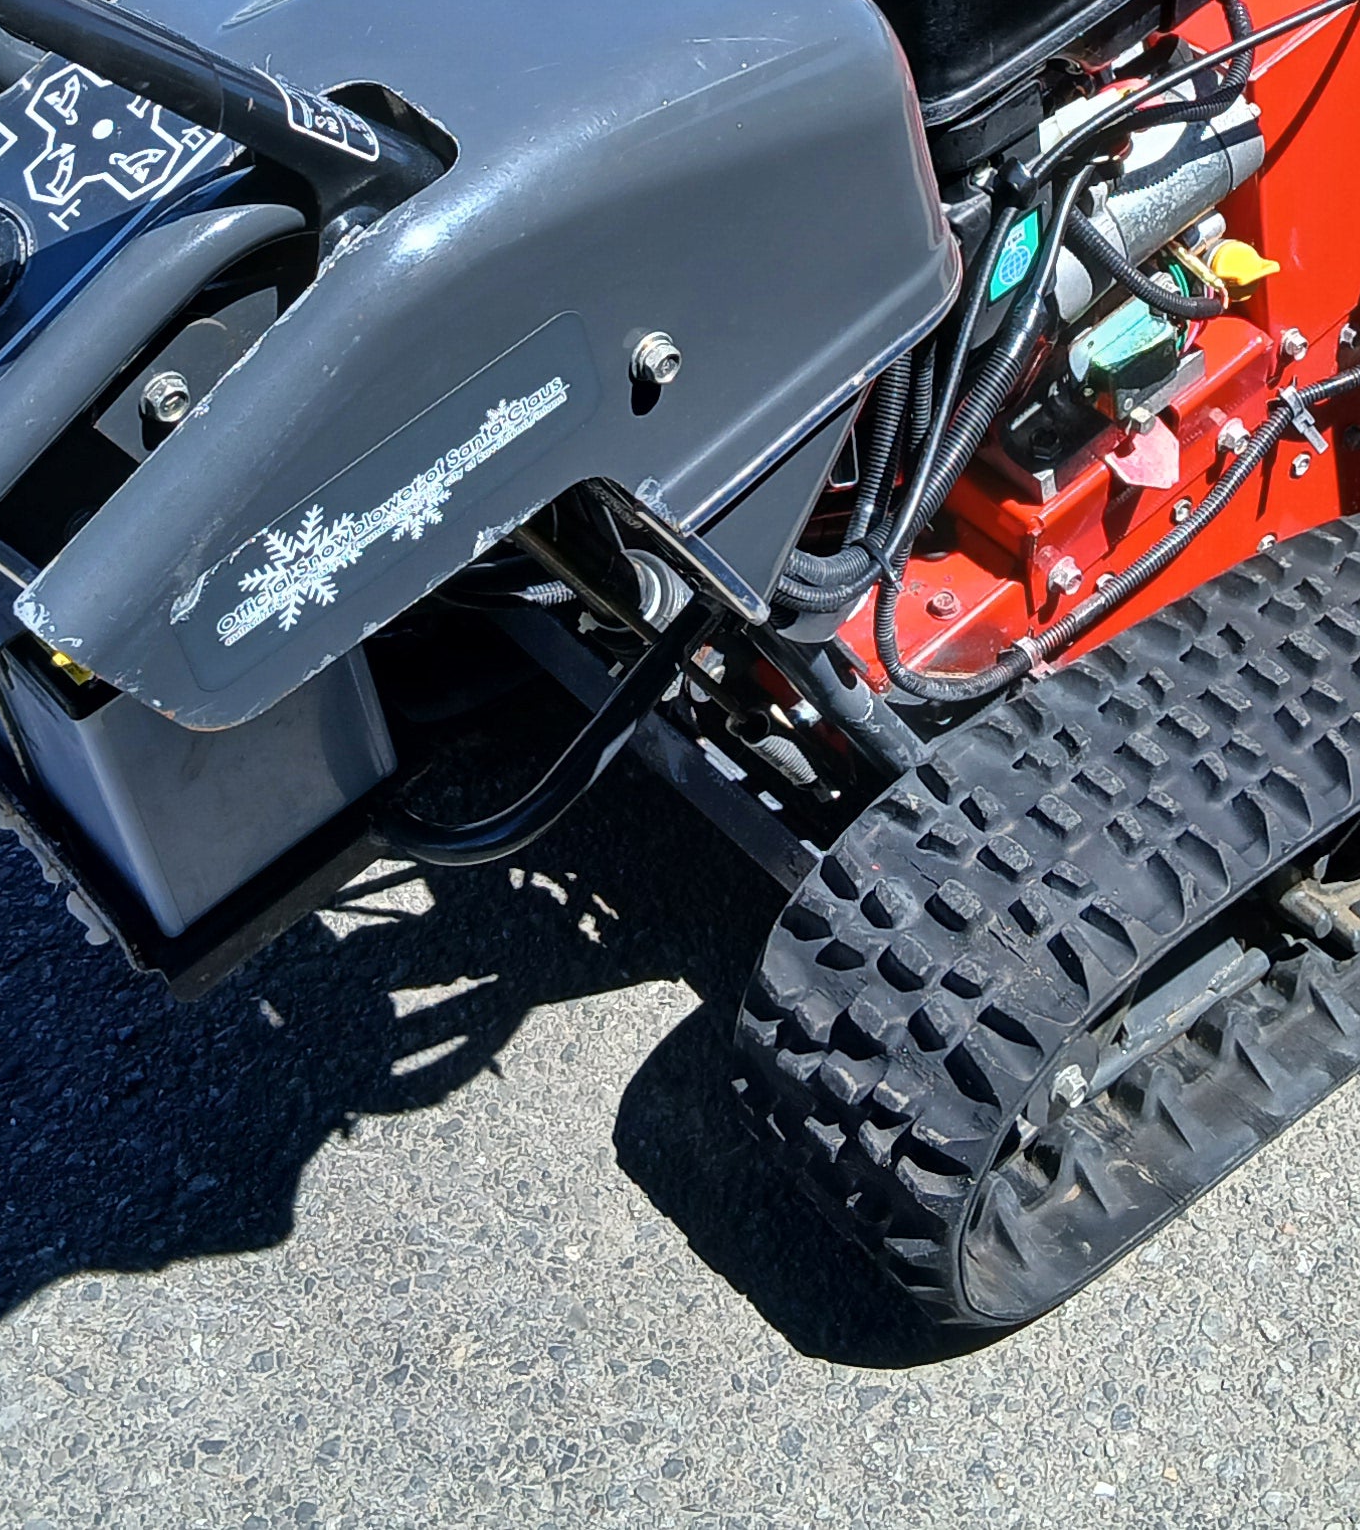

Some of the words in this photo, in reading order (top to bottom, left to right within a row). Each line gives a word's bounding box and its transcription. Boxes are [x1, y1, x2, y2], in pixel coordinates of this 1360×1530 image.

[48, 198, 82, 232] 上
[220, 571, 292, 630] Official
[295, 482, 419, 573] Snowblower
[425, 459, 444, 483] of
[447, 422, 503, 467] Santa
[508, 379, 562, 421] Claus
